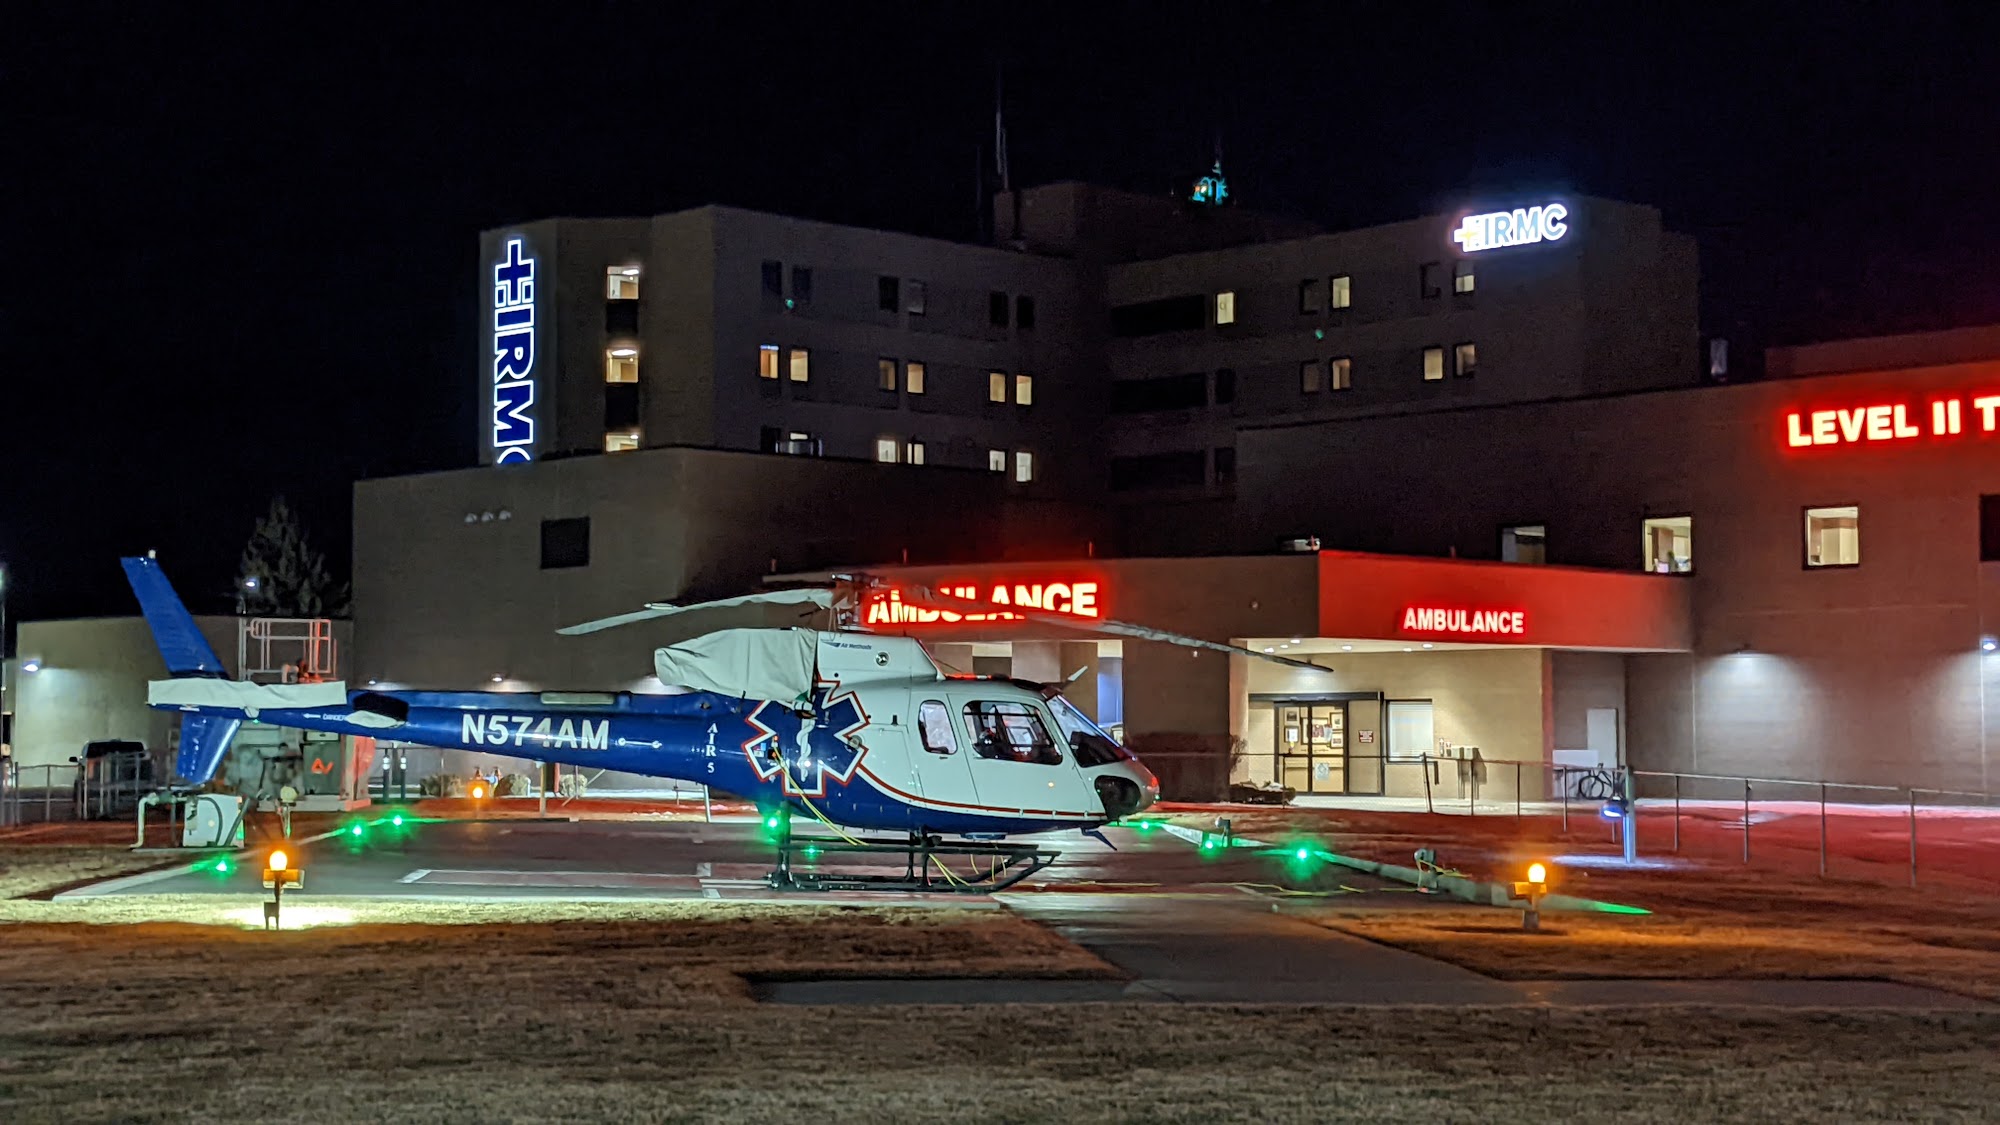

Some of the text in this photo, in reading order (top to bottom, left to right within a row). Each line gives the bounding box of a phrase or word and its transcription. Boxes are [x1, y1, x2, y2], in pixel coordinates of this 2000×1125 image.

[1482, 204, 1567, 248] IRMC
[494, 303, 535, 464] IRM
[1787, 403, 1920, 447] LEVEL
[1932, 398, 1961, 436] II
[1403, 607, 1525, 634] AMBULANCE
[461, 713, 610, 751] N574AM
[706, 722, 719, 774] AIR 5
